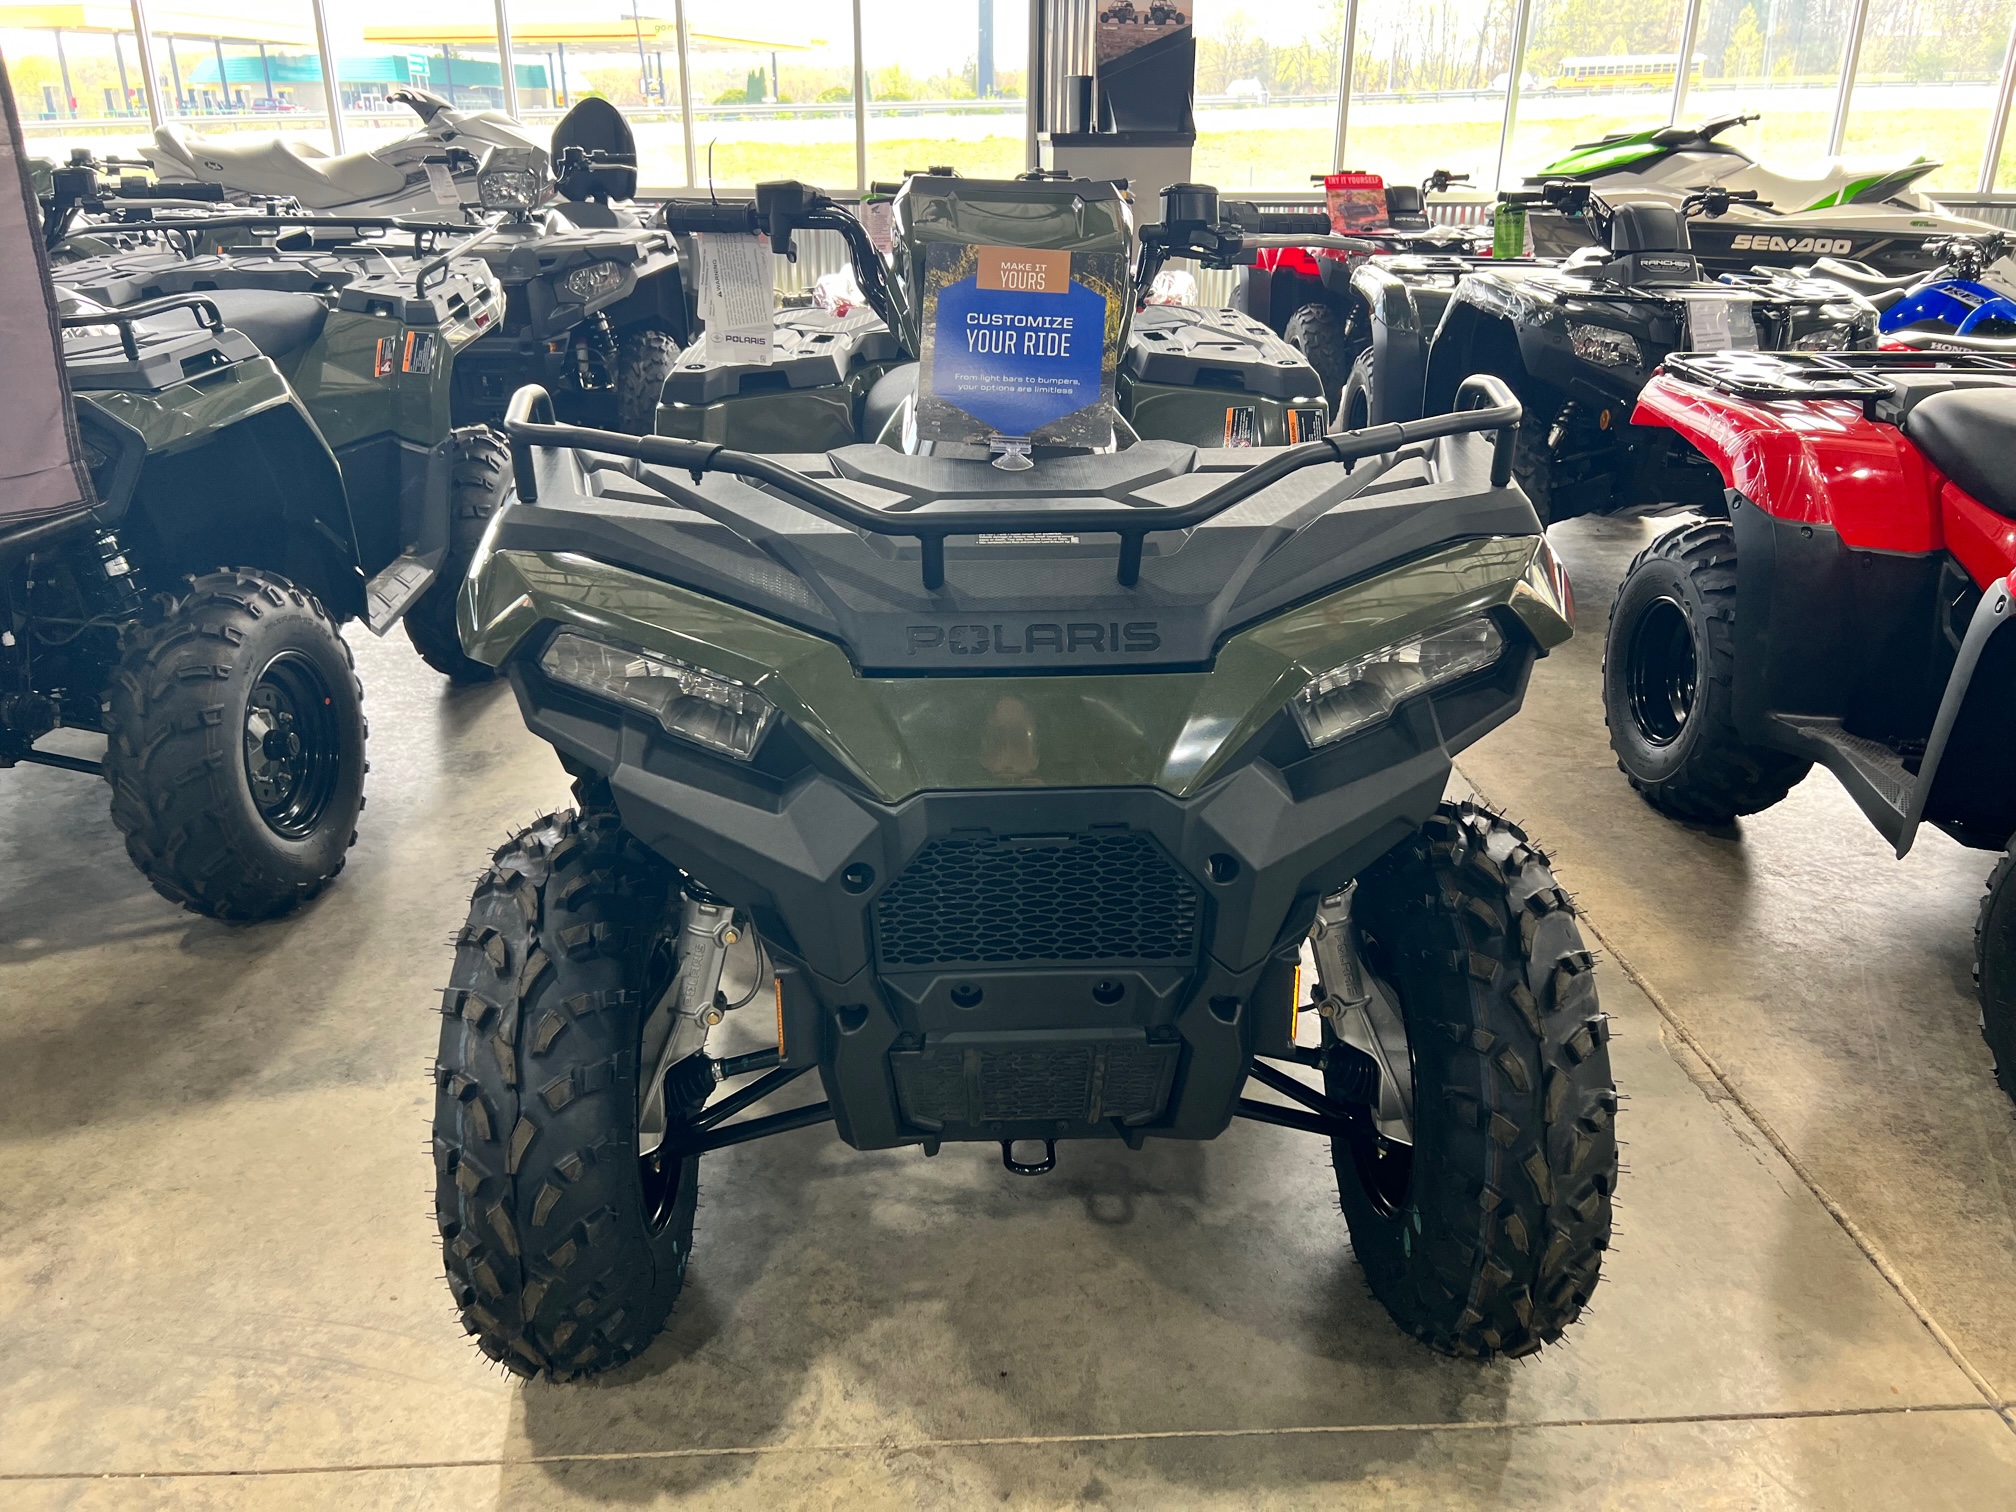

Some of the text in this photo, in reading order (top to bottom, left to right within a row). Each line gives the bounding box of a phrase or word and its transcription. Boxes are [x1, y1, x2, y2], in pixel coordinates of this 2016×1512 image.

[1328, 176, 1379, 185] TRY IT YOURSELF
[1001, 262, 1047, 272] MAKE IT
[1640, 260, 1690, 268] RANCHER
[712, 259, 722, 292] WARNING
[1001, 271, 1046, 290] YOURS
[966, 312, 1073, 329] CUSTOMIZE
[725, 335, 766, 345] POLARIS
[966, 329, 1071, 357] YOUR RIDE
[1930, 342, 1979, 352] HOND
[954, 373, 978, 381] From
[980, 374, 1000, 382] light
[1003, 375, 1023, 383] bars
[1038, 376, 1081, 386] bumpers,
[958, 384, 977, 392] your
[980, 384, 1014, 393] options
[1034, 386, 1073, 394] limitless
[906, 622, 1161, 656] POLARIS
[683, 943, 706, 1007] POLARIS
